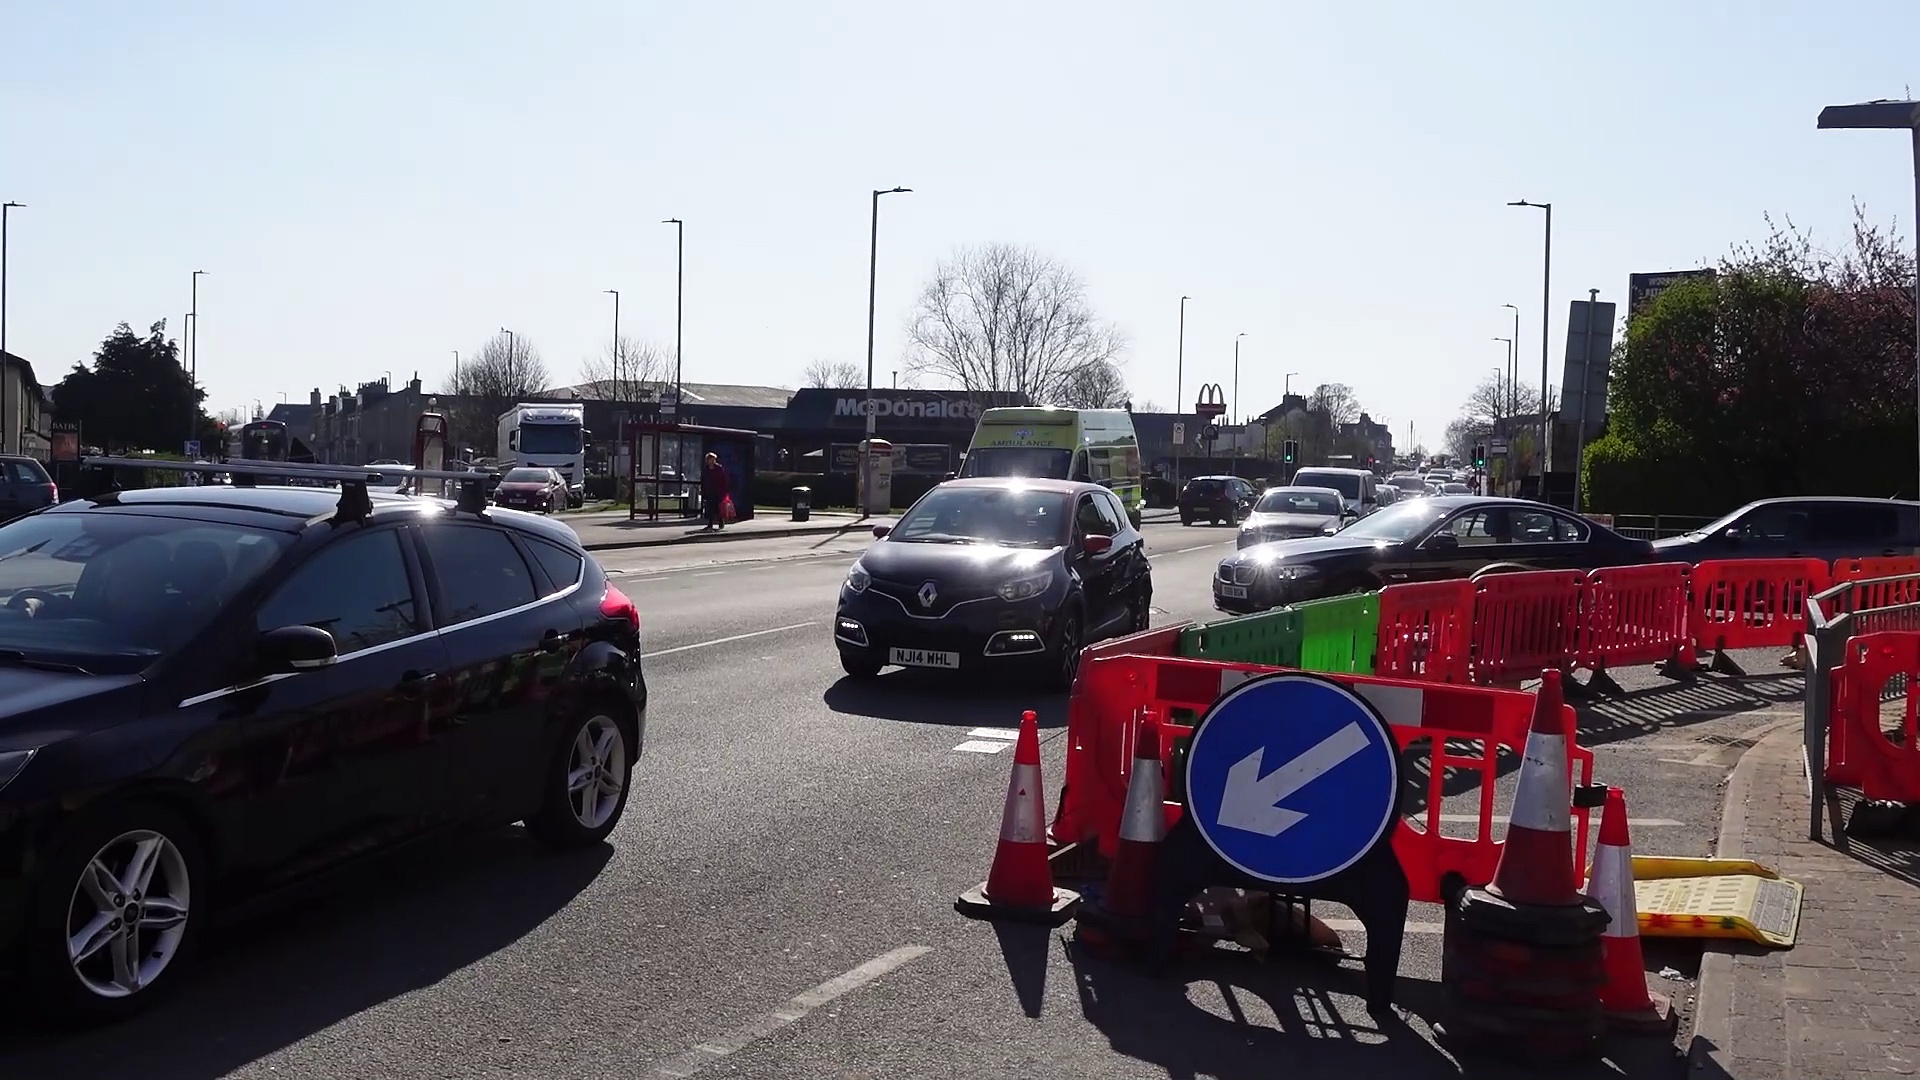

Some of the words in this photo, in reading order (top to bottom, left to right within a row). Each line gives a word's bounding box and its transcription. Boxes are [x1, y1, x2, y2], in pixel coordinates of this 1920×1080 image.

[835, 398, 982, 418] McDonald's
[991, 439, 1055, 447] AMBULANCE
[897, 649, 923, 663] NJ14
[927, 652, 951, 666] WHL
